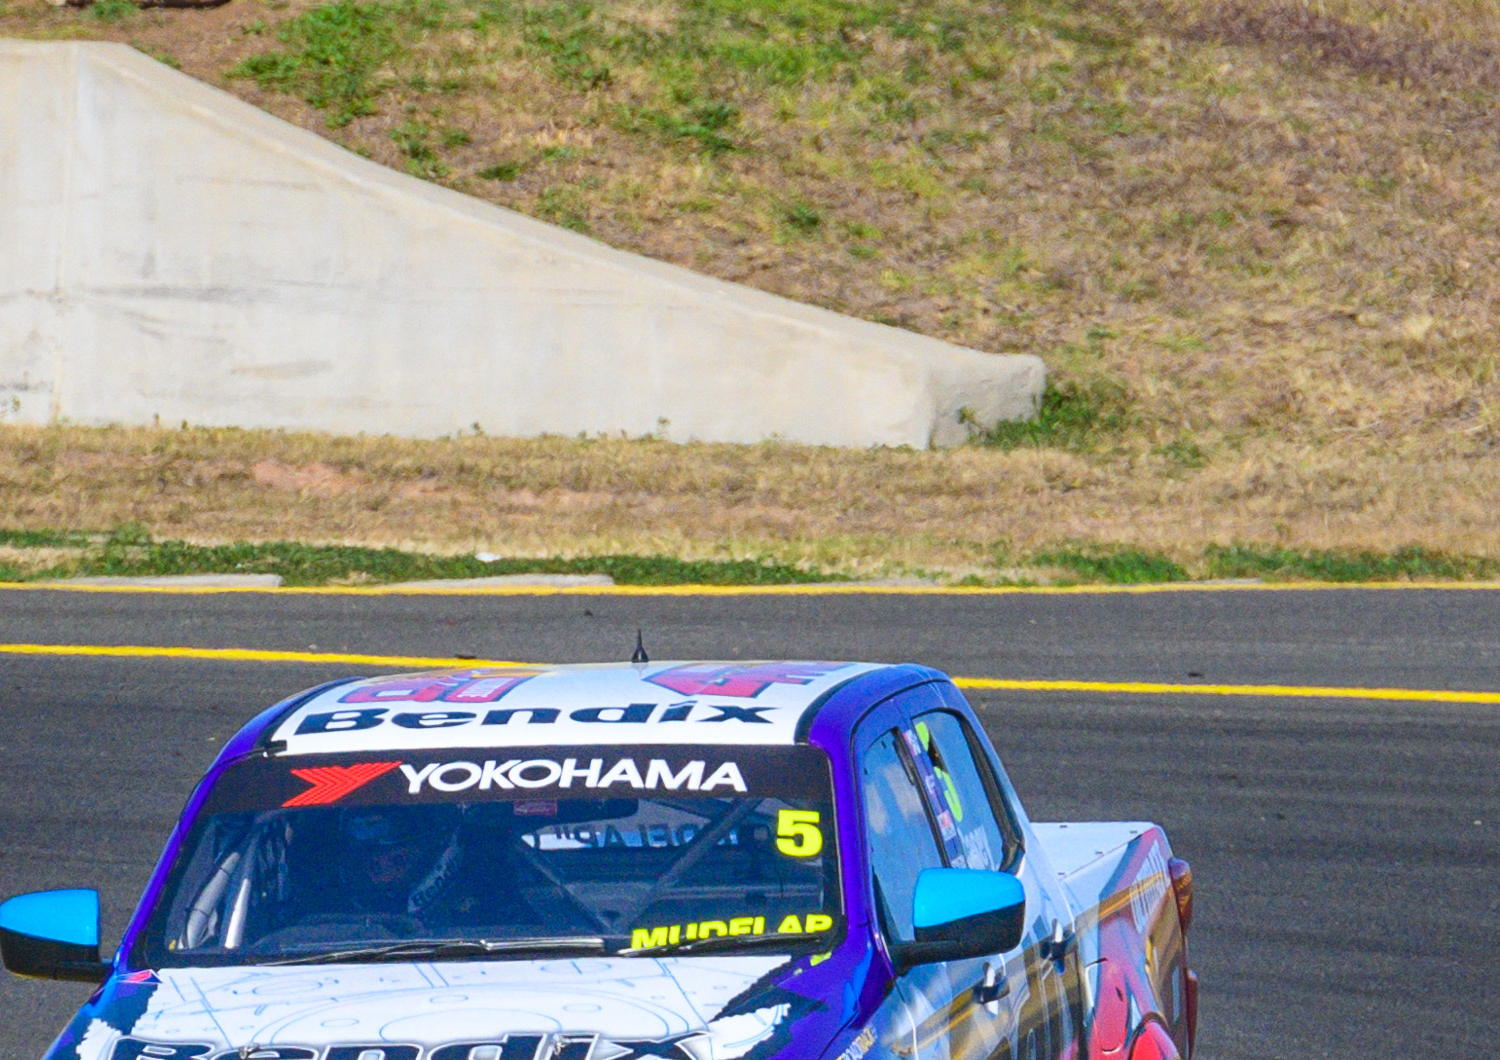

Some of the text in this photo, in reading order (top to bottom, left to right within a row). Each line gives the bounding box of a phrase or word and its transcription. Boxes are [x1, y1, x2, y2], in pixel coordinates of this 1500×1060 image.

[294, 701, 778, 736] Bendix
[398, 757, 748, 794] YOKOHAMA
[777, 809, 823, 857] 5
